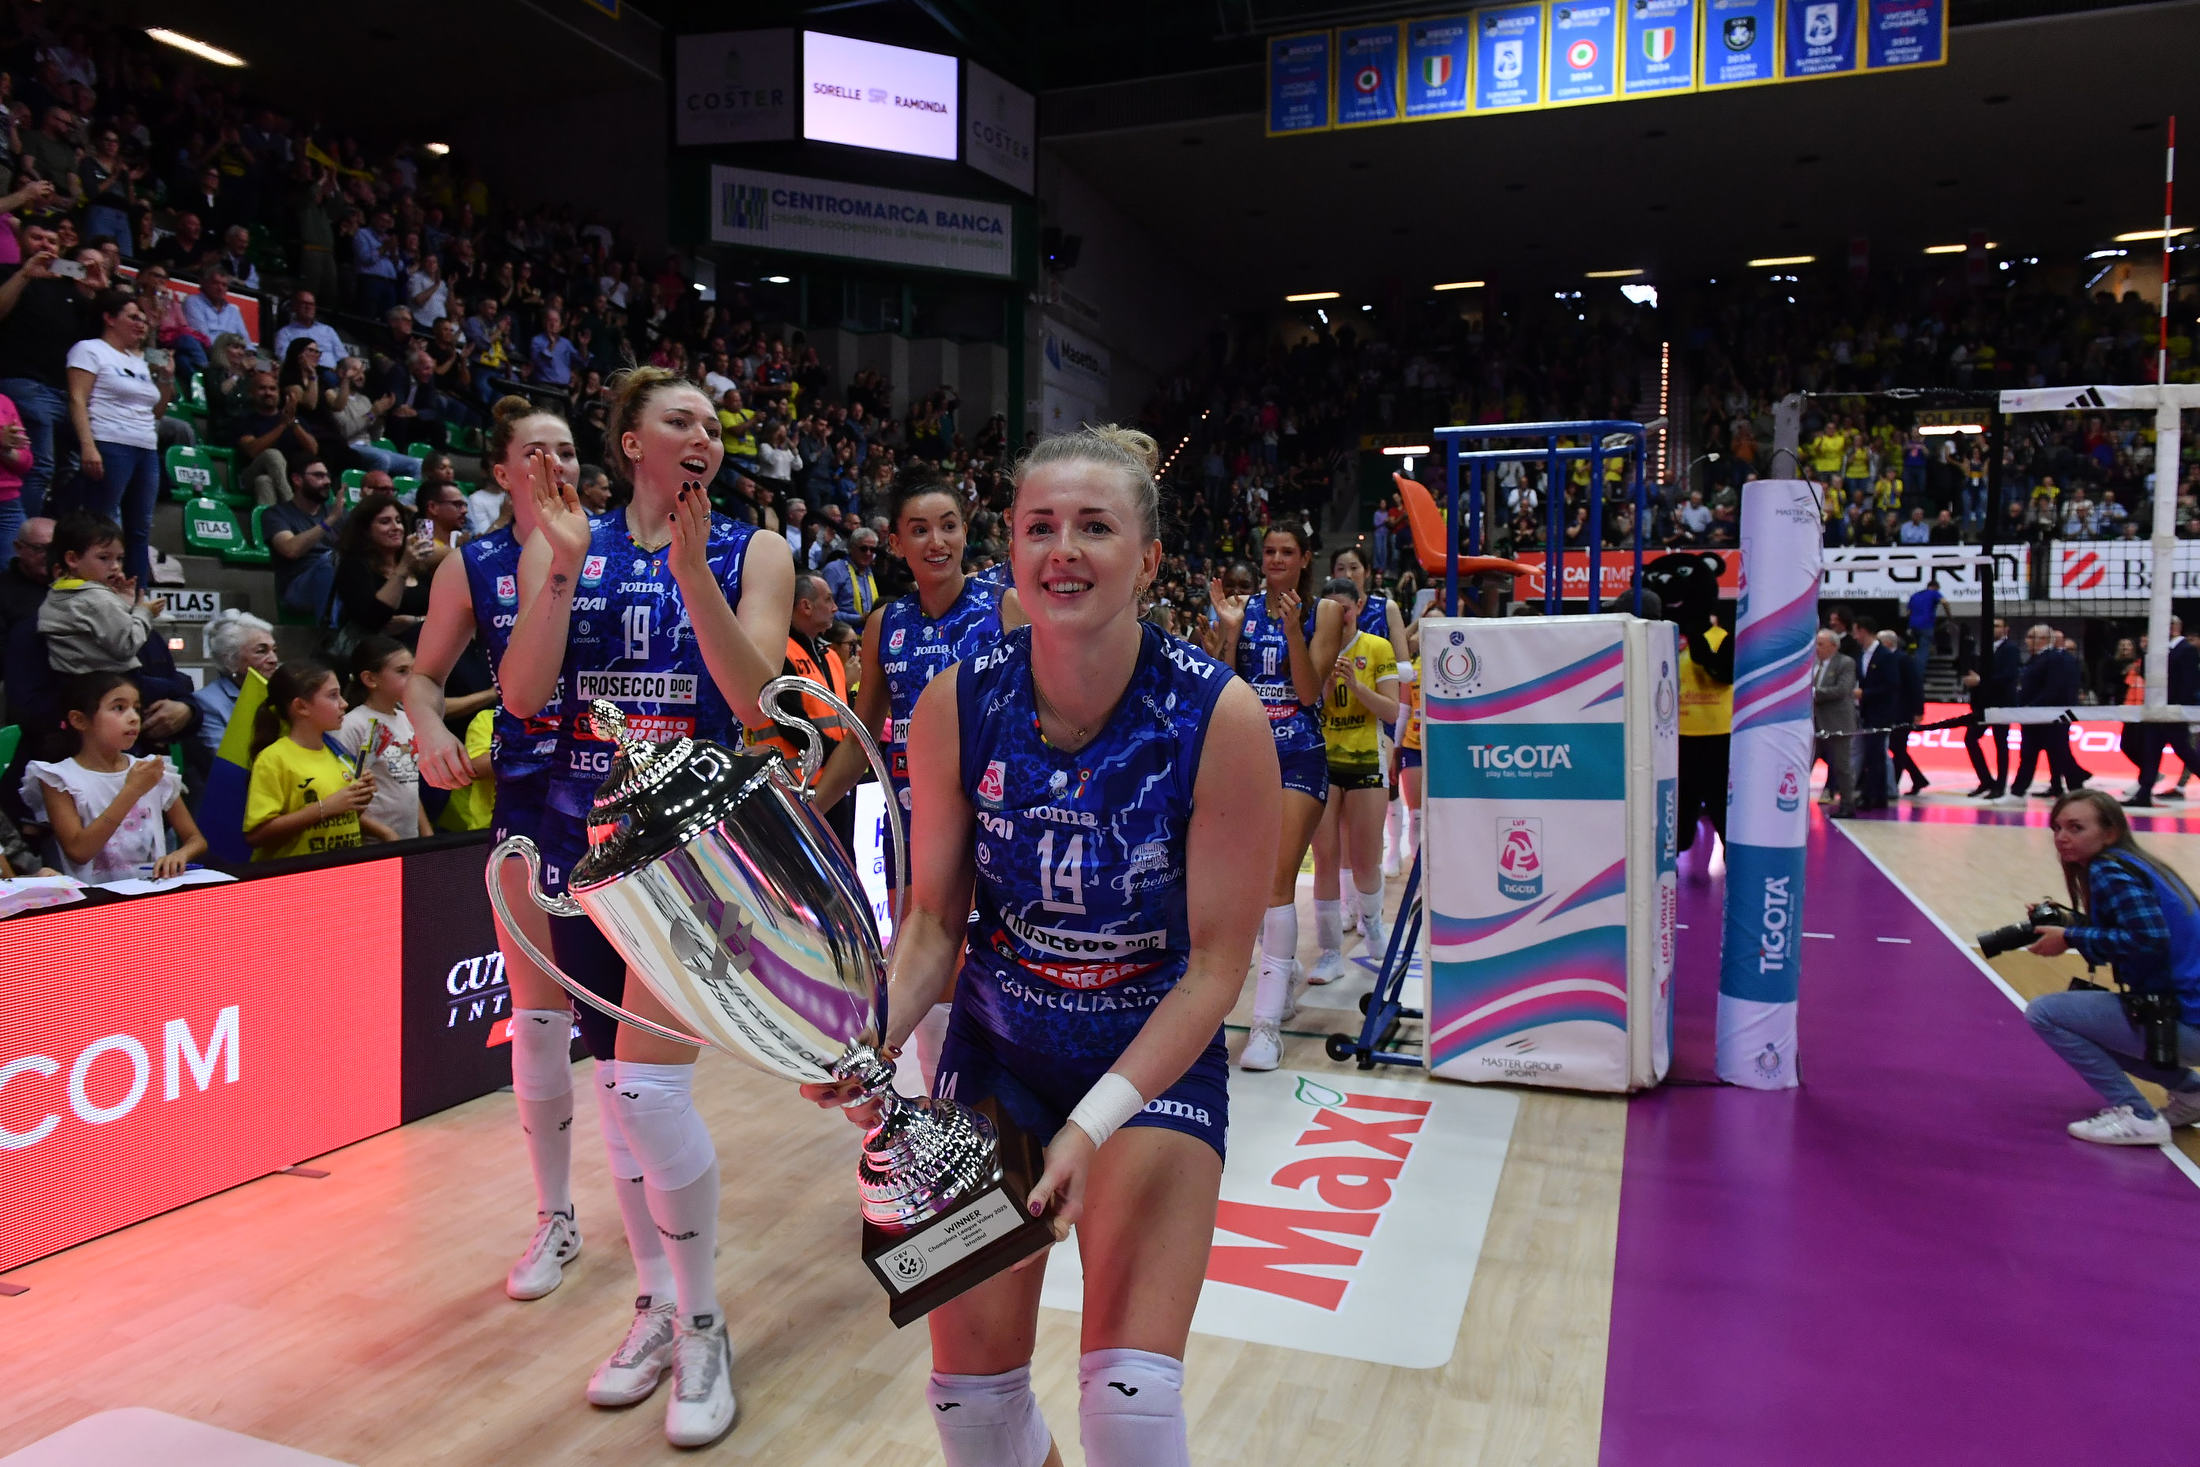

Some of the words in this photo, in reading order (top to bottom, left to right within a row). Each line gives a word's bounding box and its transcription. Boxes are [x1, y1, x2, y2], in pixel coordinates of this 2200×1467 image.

[687, 89, 784, 111] COSTER
[813, 82, 861, 100] SORELLE
[895, 95, 948, 114] RAMONDA
[972, 120, 1030, 160] COSTER
[771, 189, 929, 226] CENTROMARCA
[935, 210, 1004, 236] BANCA
[178, 469, 206, 481] ITLAS
[196, 522, 230, 534] ITLAS
[156, 594, 214, 611] TLAS
[493, 614, 519, 628] CRA
[621, 605, 652, 660] 19
[580, 675, 666, 698] PROSECCO
[669, 679, 693, 692] DOC
[1255, 686, 1283, 697] SECCO
[629, 718, 689, 730] TONIO
[977, 812, 1014, 840] RAI
[1037, 829, 1087, 915] 14
[1660, 884, 1670, 930] VOLLEY
[1661, 934, 1670, 964] LEGA
[1481, 1057, 1521, 1069] MASTER
[1523, 1060, 1563, 1073] GROUP
[1504, 1069, 1538, 1078] SPORT
[1141, 1099, 1212, 1126] oma
[927, 1234, 959, 1253] Champions
[957, 1222, 978, 1238] League
[993, 1204, 1008, 1215] 2025
[943, 1209, 982, 1234] WINNER
[961, 1227, 983, 1241] Women
[893, 1250, 908, 1262] CEV
